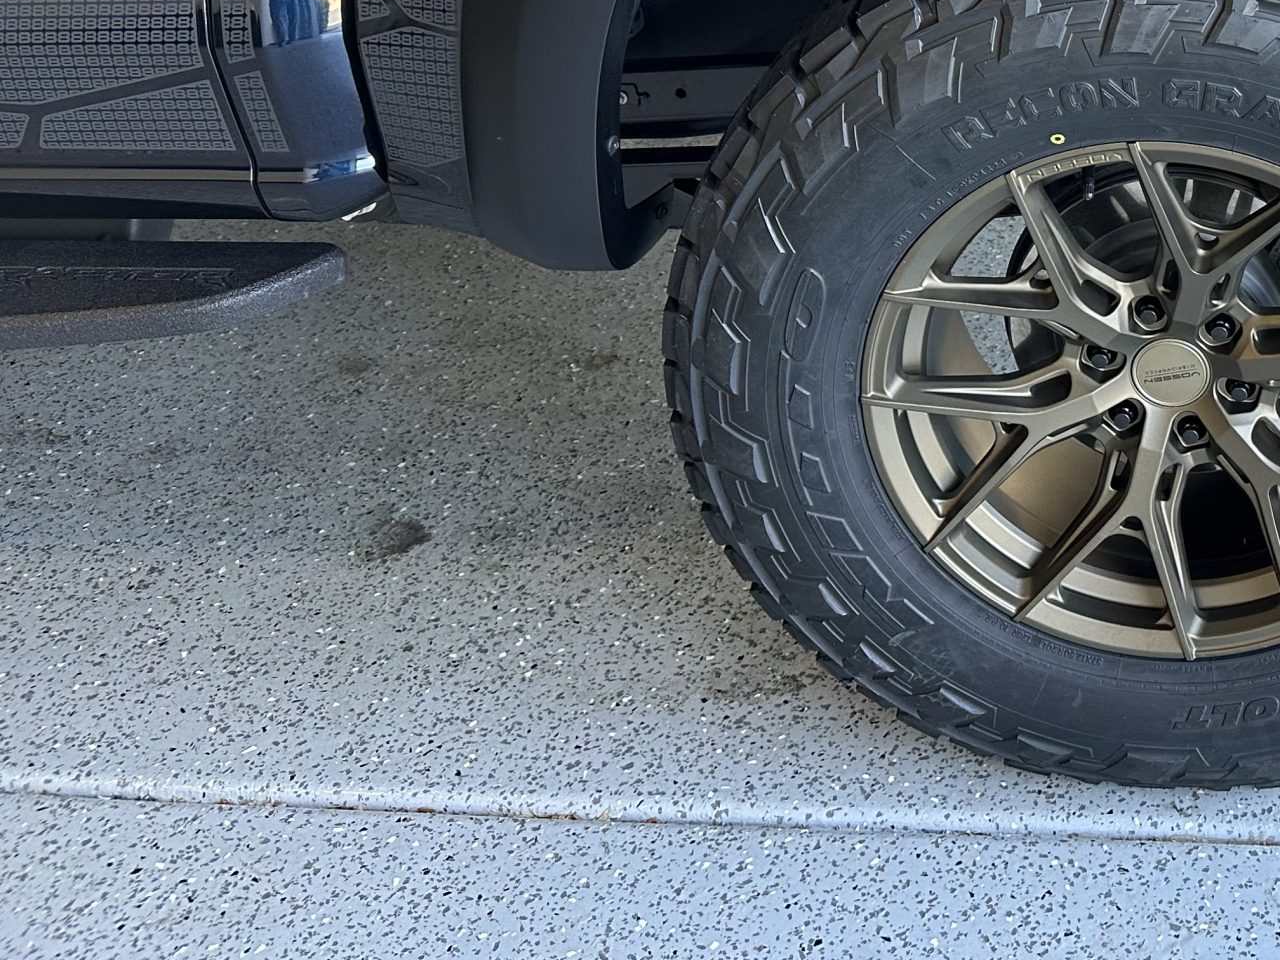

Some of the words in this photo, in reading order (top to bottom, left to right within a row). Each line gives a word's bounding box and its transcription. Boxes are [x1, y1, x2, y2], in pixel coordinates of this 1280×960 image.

[941, 77, 1139, 153] RECON
[1143, 371, 1201, 385] VOSSEN
[779, 268, 936, 630] NITTO
